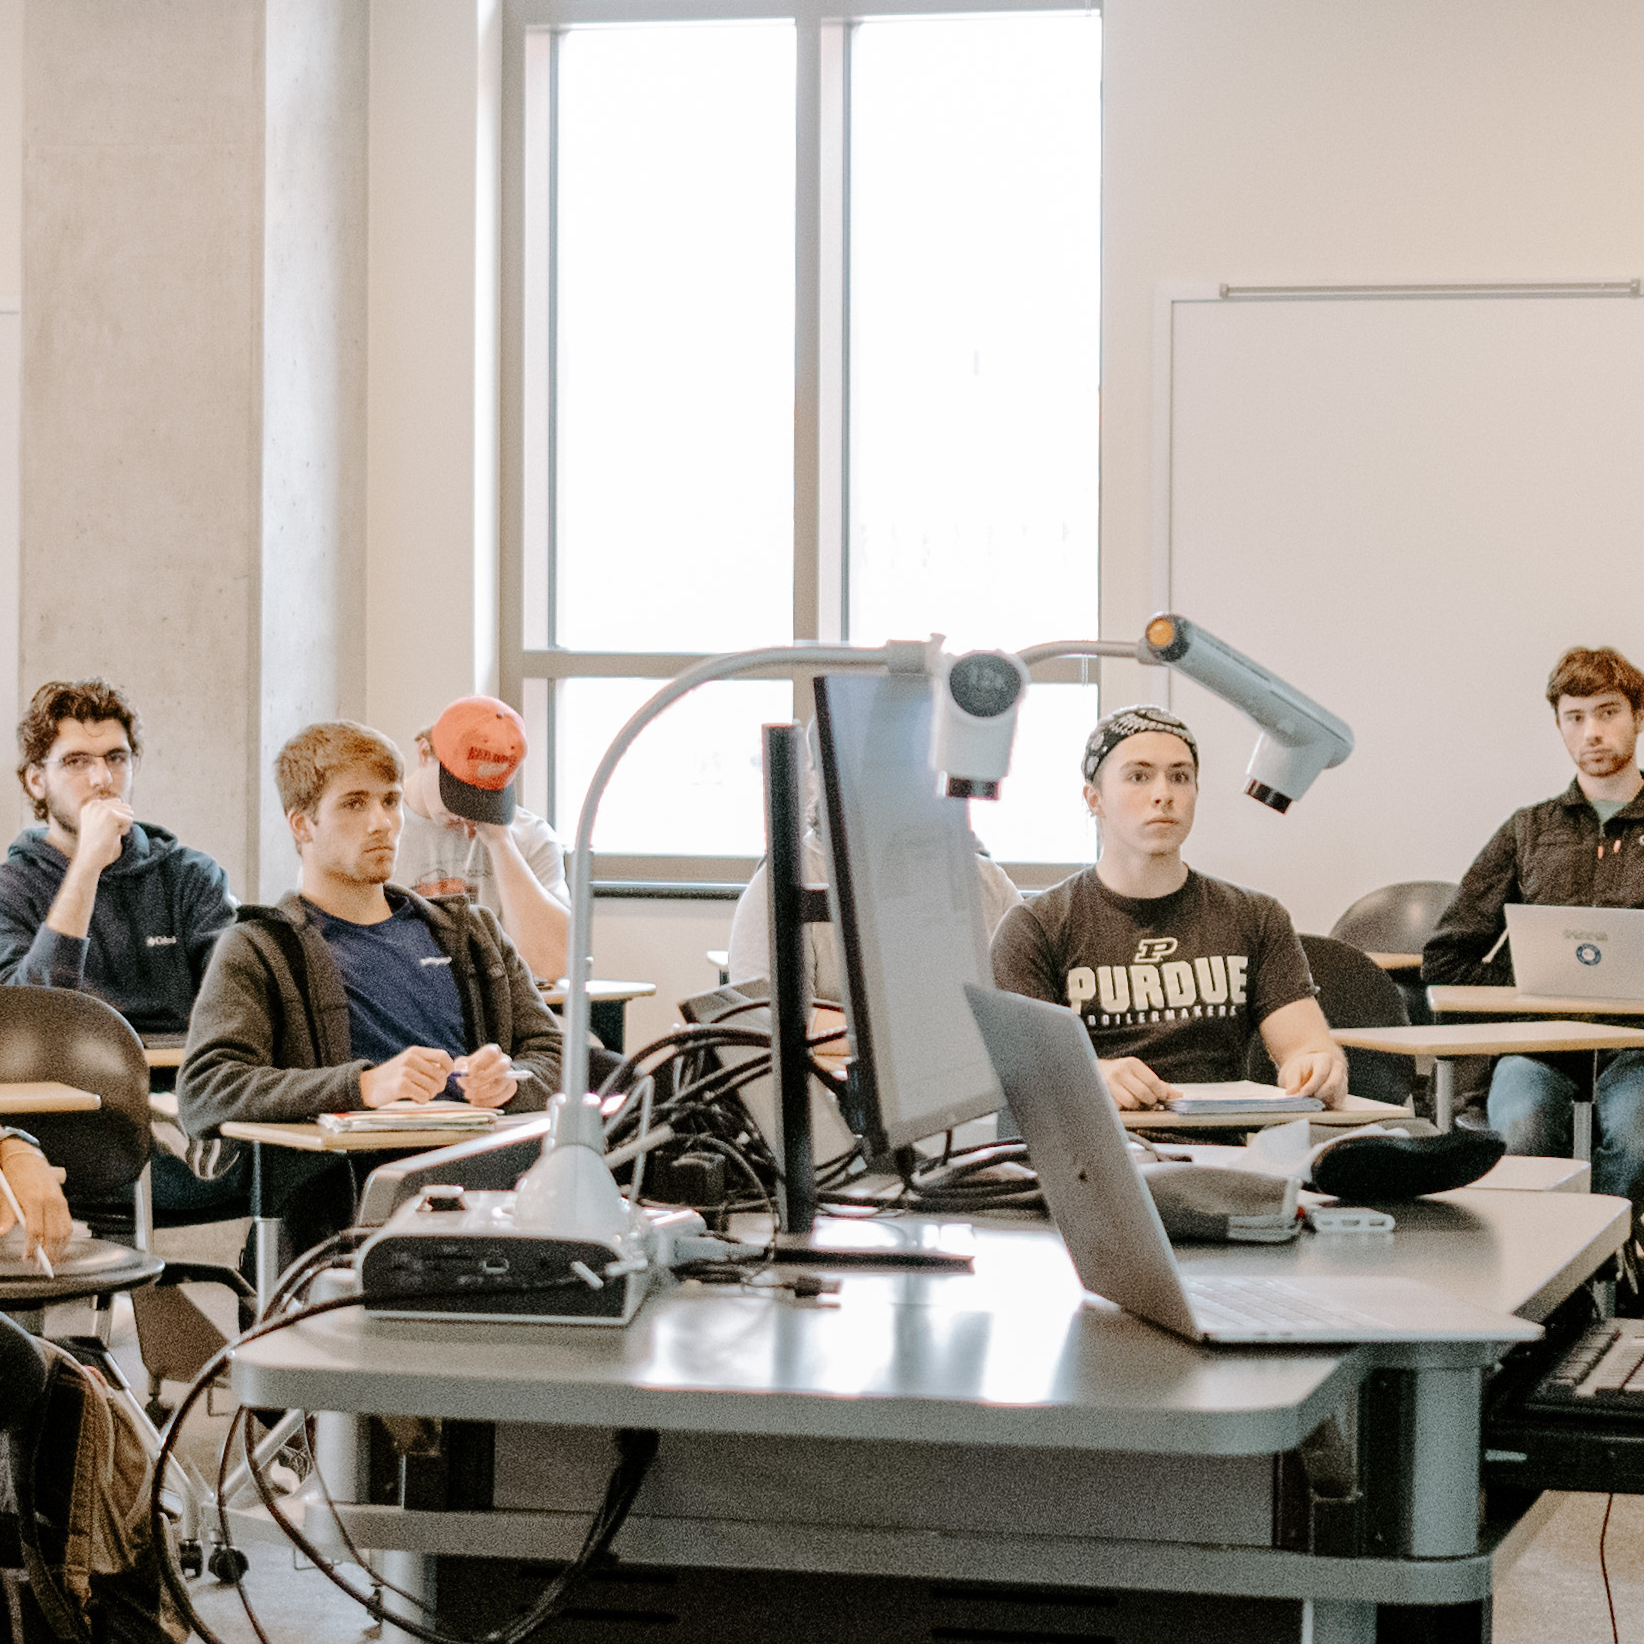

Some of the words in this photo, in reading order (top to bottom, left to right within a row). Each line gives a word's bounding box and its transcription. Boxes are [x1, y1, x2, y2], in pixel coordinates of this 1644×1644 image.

[1134, 937, 1178, 964] P
[1068, 955, 1249, 1015] PURDUE
[1087, 1005, 1238, 1027] BOILERMAKERS
